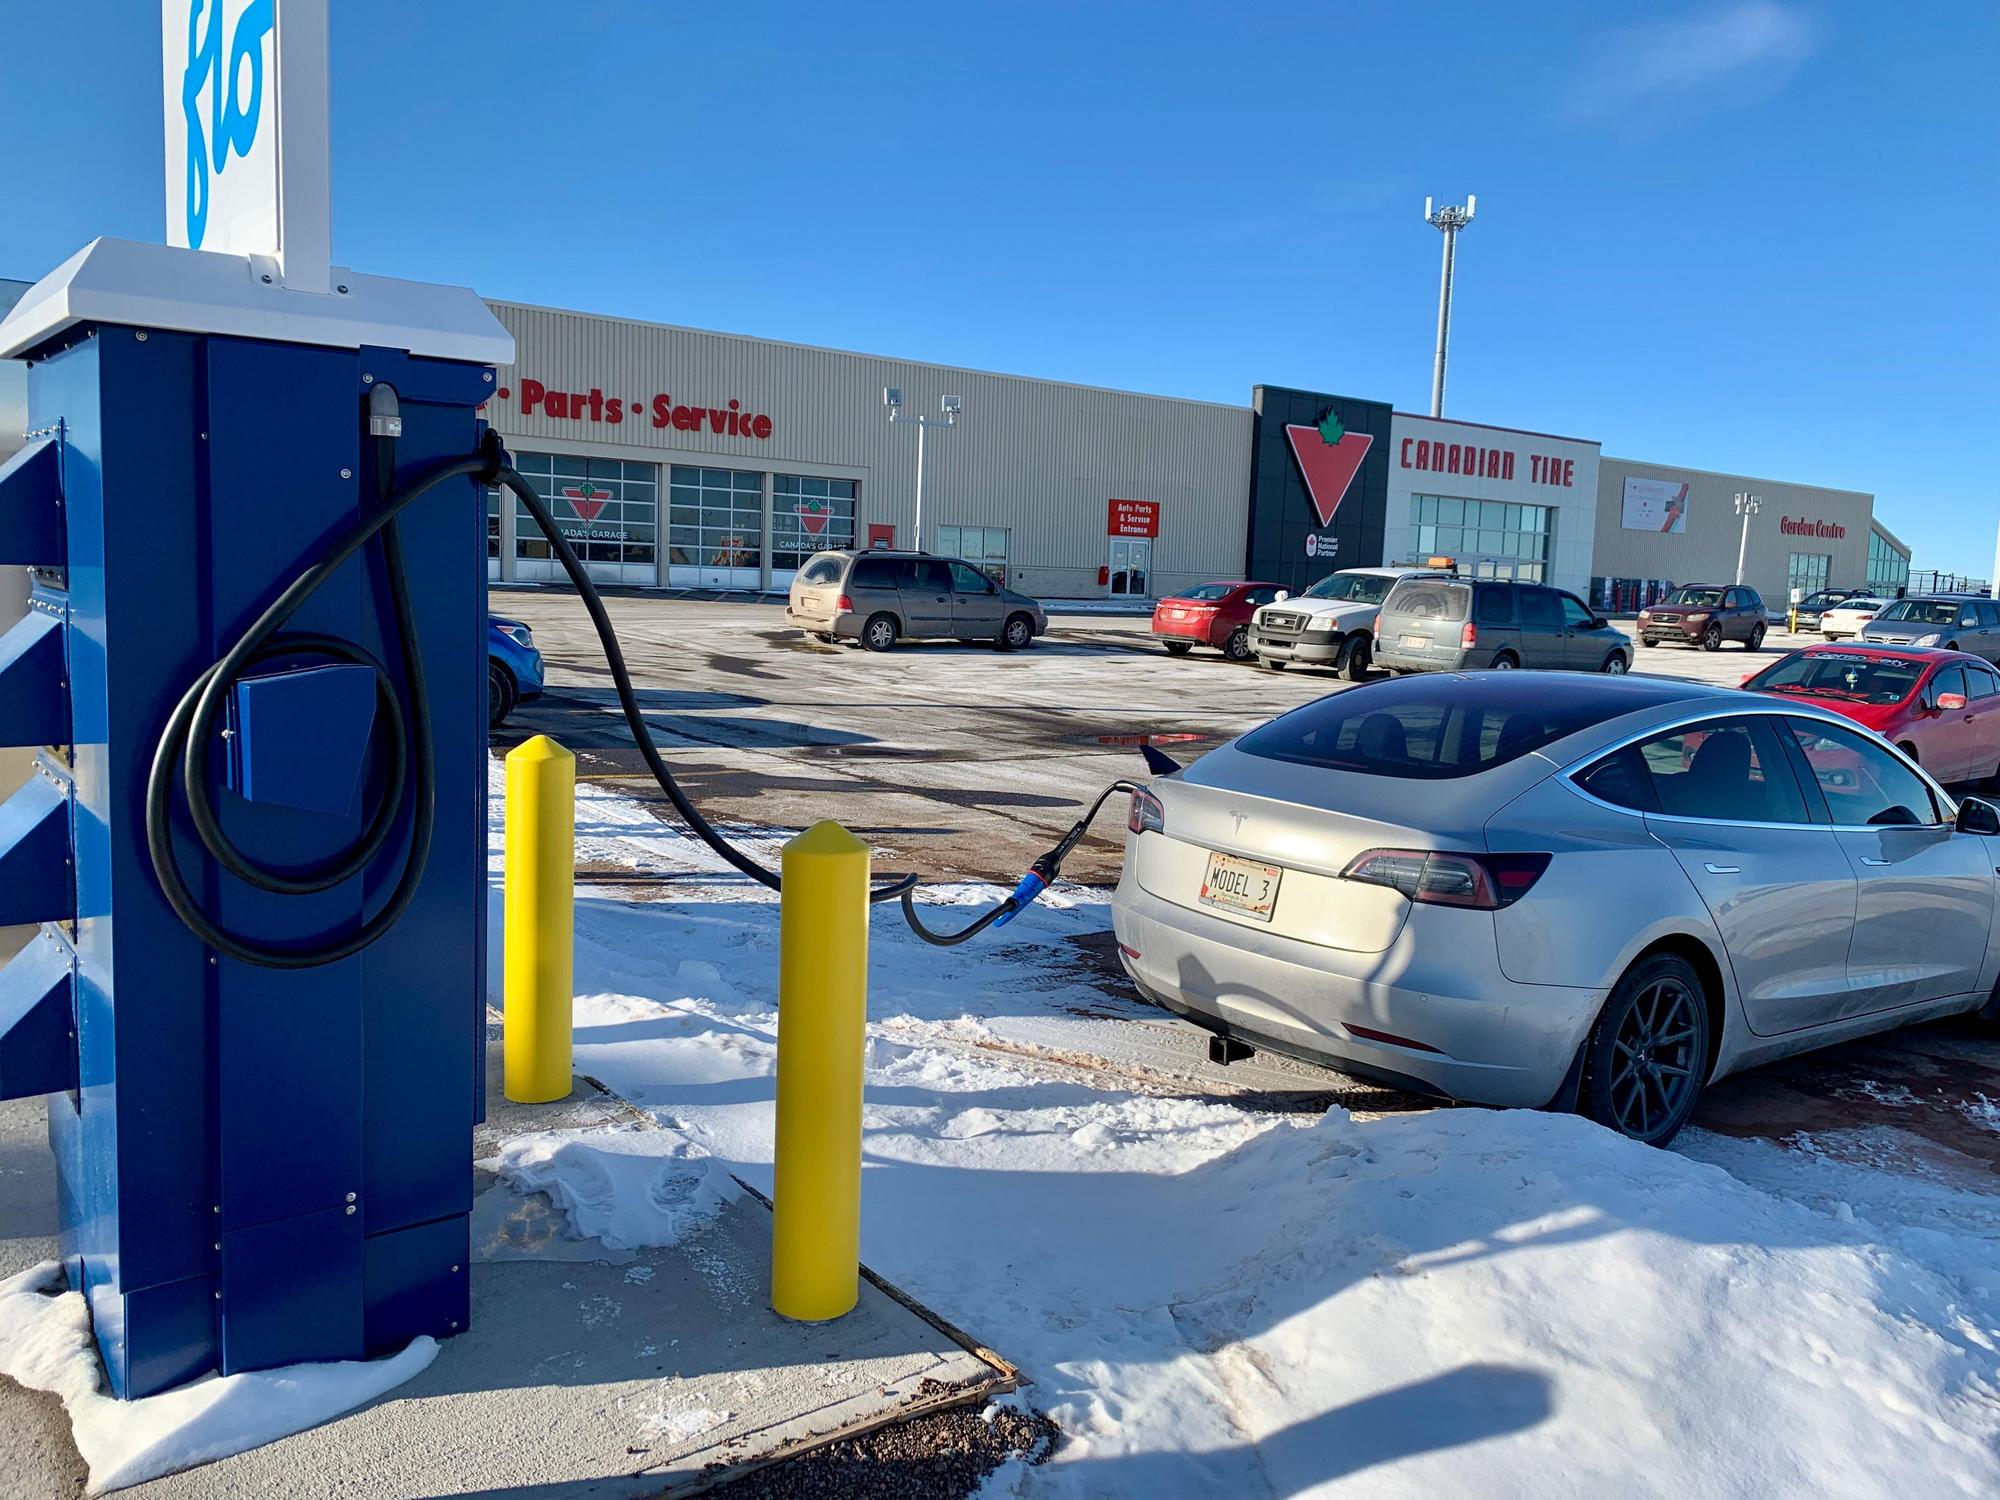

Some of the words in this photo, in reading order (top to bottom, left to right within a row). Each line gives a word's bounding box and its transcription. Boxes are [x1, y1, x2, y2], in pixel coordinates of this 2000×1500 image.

[521, 378, 623, 424] Parts
[652, 393, 772, 439] Service
[1400, 437, 1515, 481] CANADIAN
[1530, 454, 1574, 487] TIRE
[1118, 503, 1133, 512] Auto
[1135, 504, 1152, 514] Parts
[1119, 513, 1125, 522] &
[1127, 513, 1151, 524] Service
[1120, 524, 1148, 534] Entrance
[1780, 515, 1815, 537] Garden
[1815, 519, 1846, 539] Centre
[591, 530, 628, 539] GARAGE
[1318, 535, 1339, 543] Premier
[779, 541, 817, 550] CANADA'S
[1317, 542, 1339, 550] National
[1317, 549, 1337, 557] Partner
[1210, 867, 1249, 897] MODEL
[1258, 879, 1271, 901] 3
